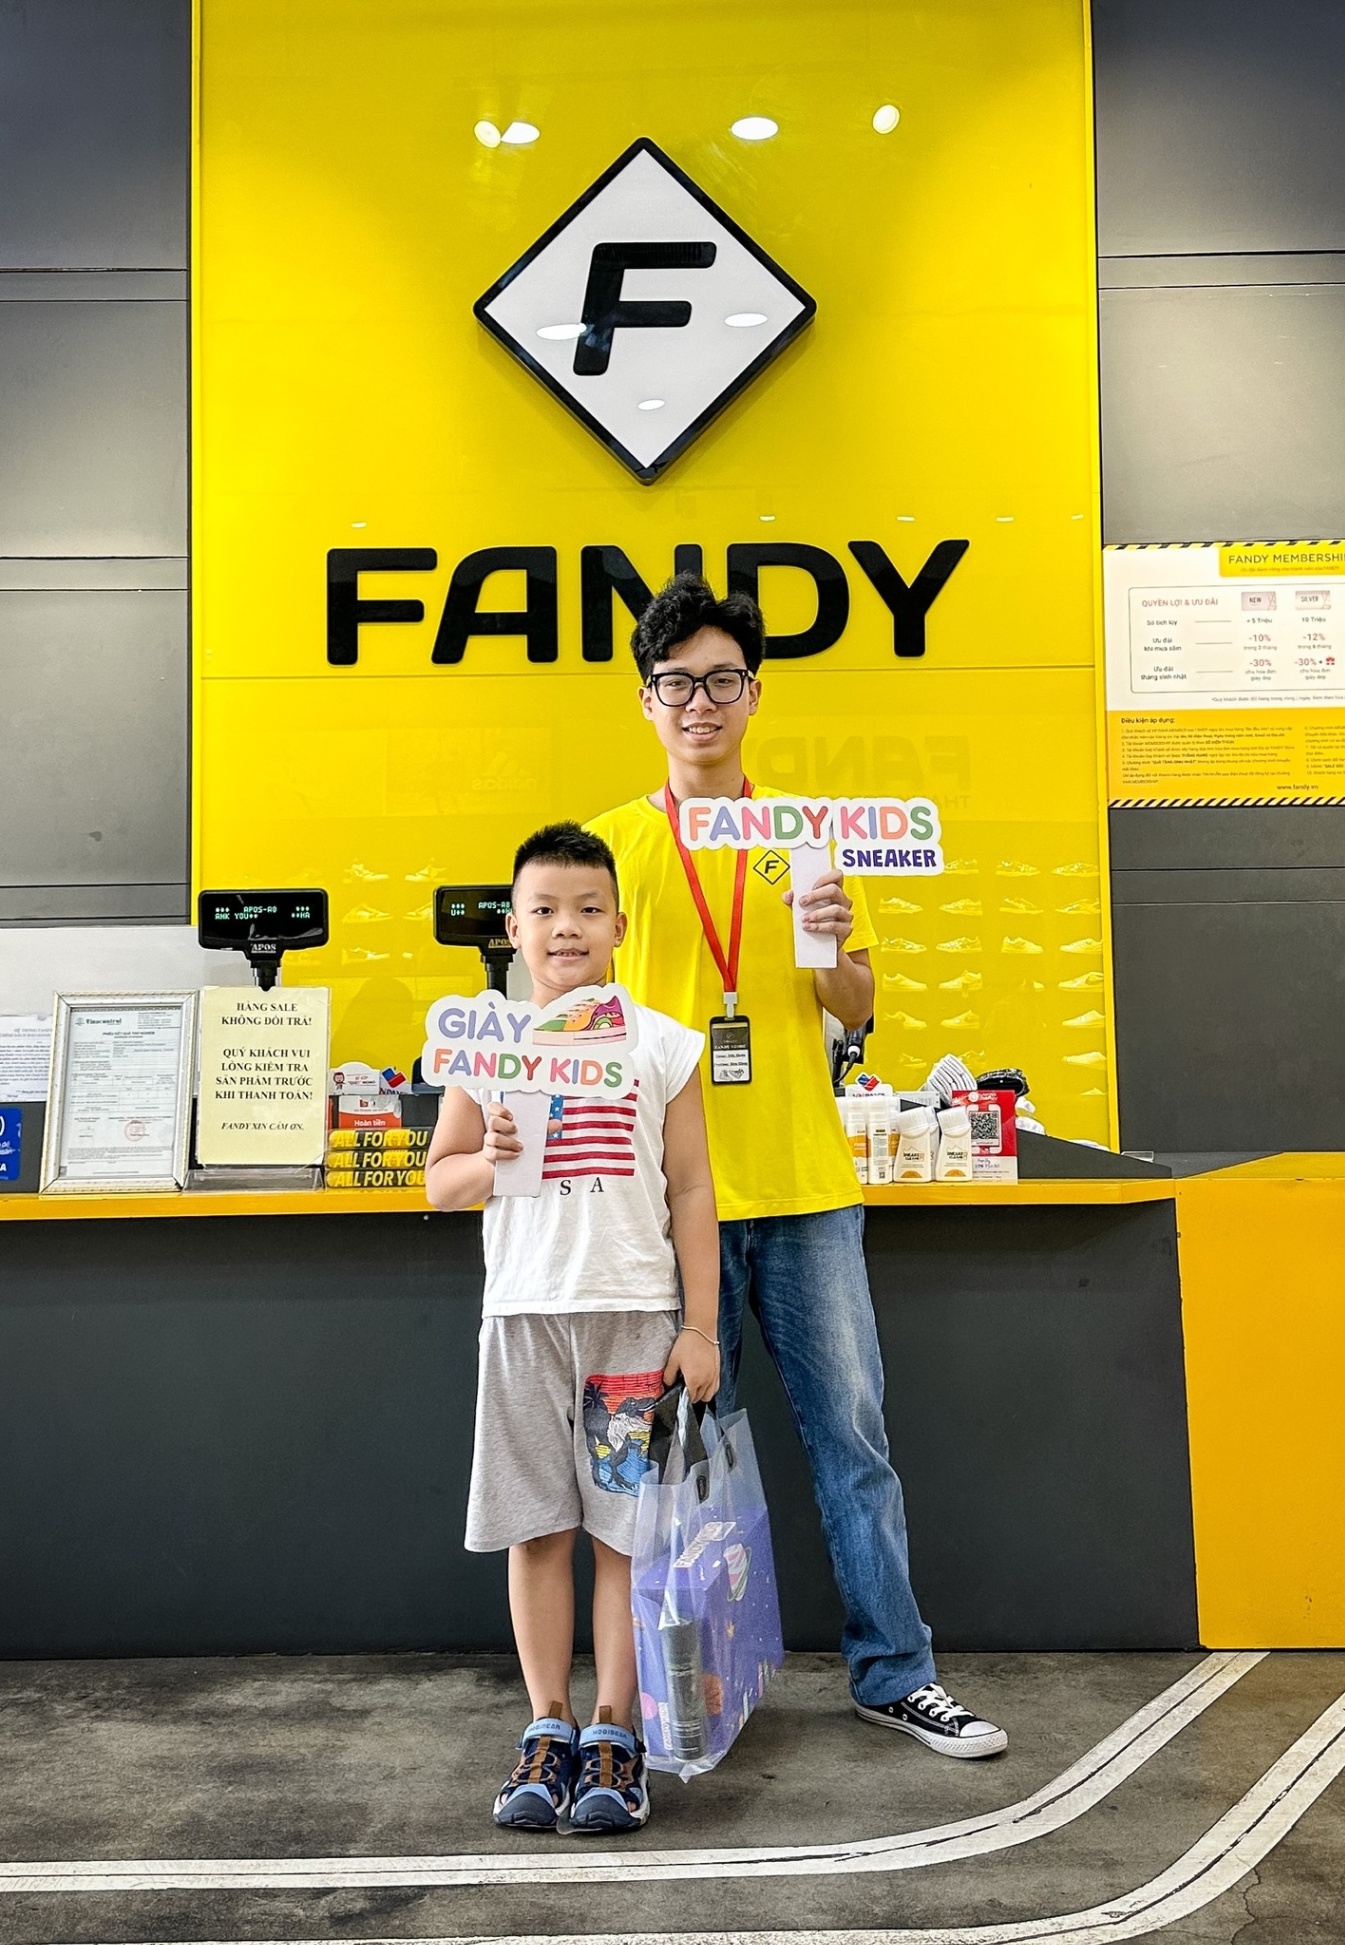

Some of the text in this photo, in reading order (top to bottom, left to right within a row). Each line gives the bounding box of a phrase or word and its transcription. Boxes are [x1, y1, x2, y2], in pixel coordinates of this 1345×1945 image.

[573, 241, 717, 376] F
[1228, 554, 1269, 564] FANDY
[327, 539, 970, 665] FANDY
[1249, 634, 1271, 642] -10%
[1302, 633, 1326, 641] -12%
[1250, 658, 1272, 667] -30%
[688, 806, 934, 841] FANDY KIDS
[842, 849, 937, 868] SNEAKER
[251, 943, 276, 952] APOS
[236, 1001, 298, 1012] HÀNG SALE
[222, 1014, 262, 1025] KHÔNG
[438, 1002, 532, 1044] GIÀY
[223, 1046, 310, 1058] QUÝ KHÁCH VUI
[222, 1060, 252, 1071] LÒNG
[286, 1063, 308, 1072] TRA
[434, 1048, 622, 1088] FANDY KIDS
[275, 1074, 314, 1086] TRƯỚC
[215, 1090, 313, 1100] KHI THANH TOÁN!
[221, 1122, 252, 1130] FANDY
[252, 1122, 268, 1130] XIN
[334, 1130, 428, 1148] ALL FOR YOU
[334, 1151, 426, 1168] ALL FOR YOU
[334, 1170, 361, 1187] ALL
[364, 1170, 394, 1186] FOR
